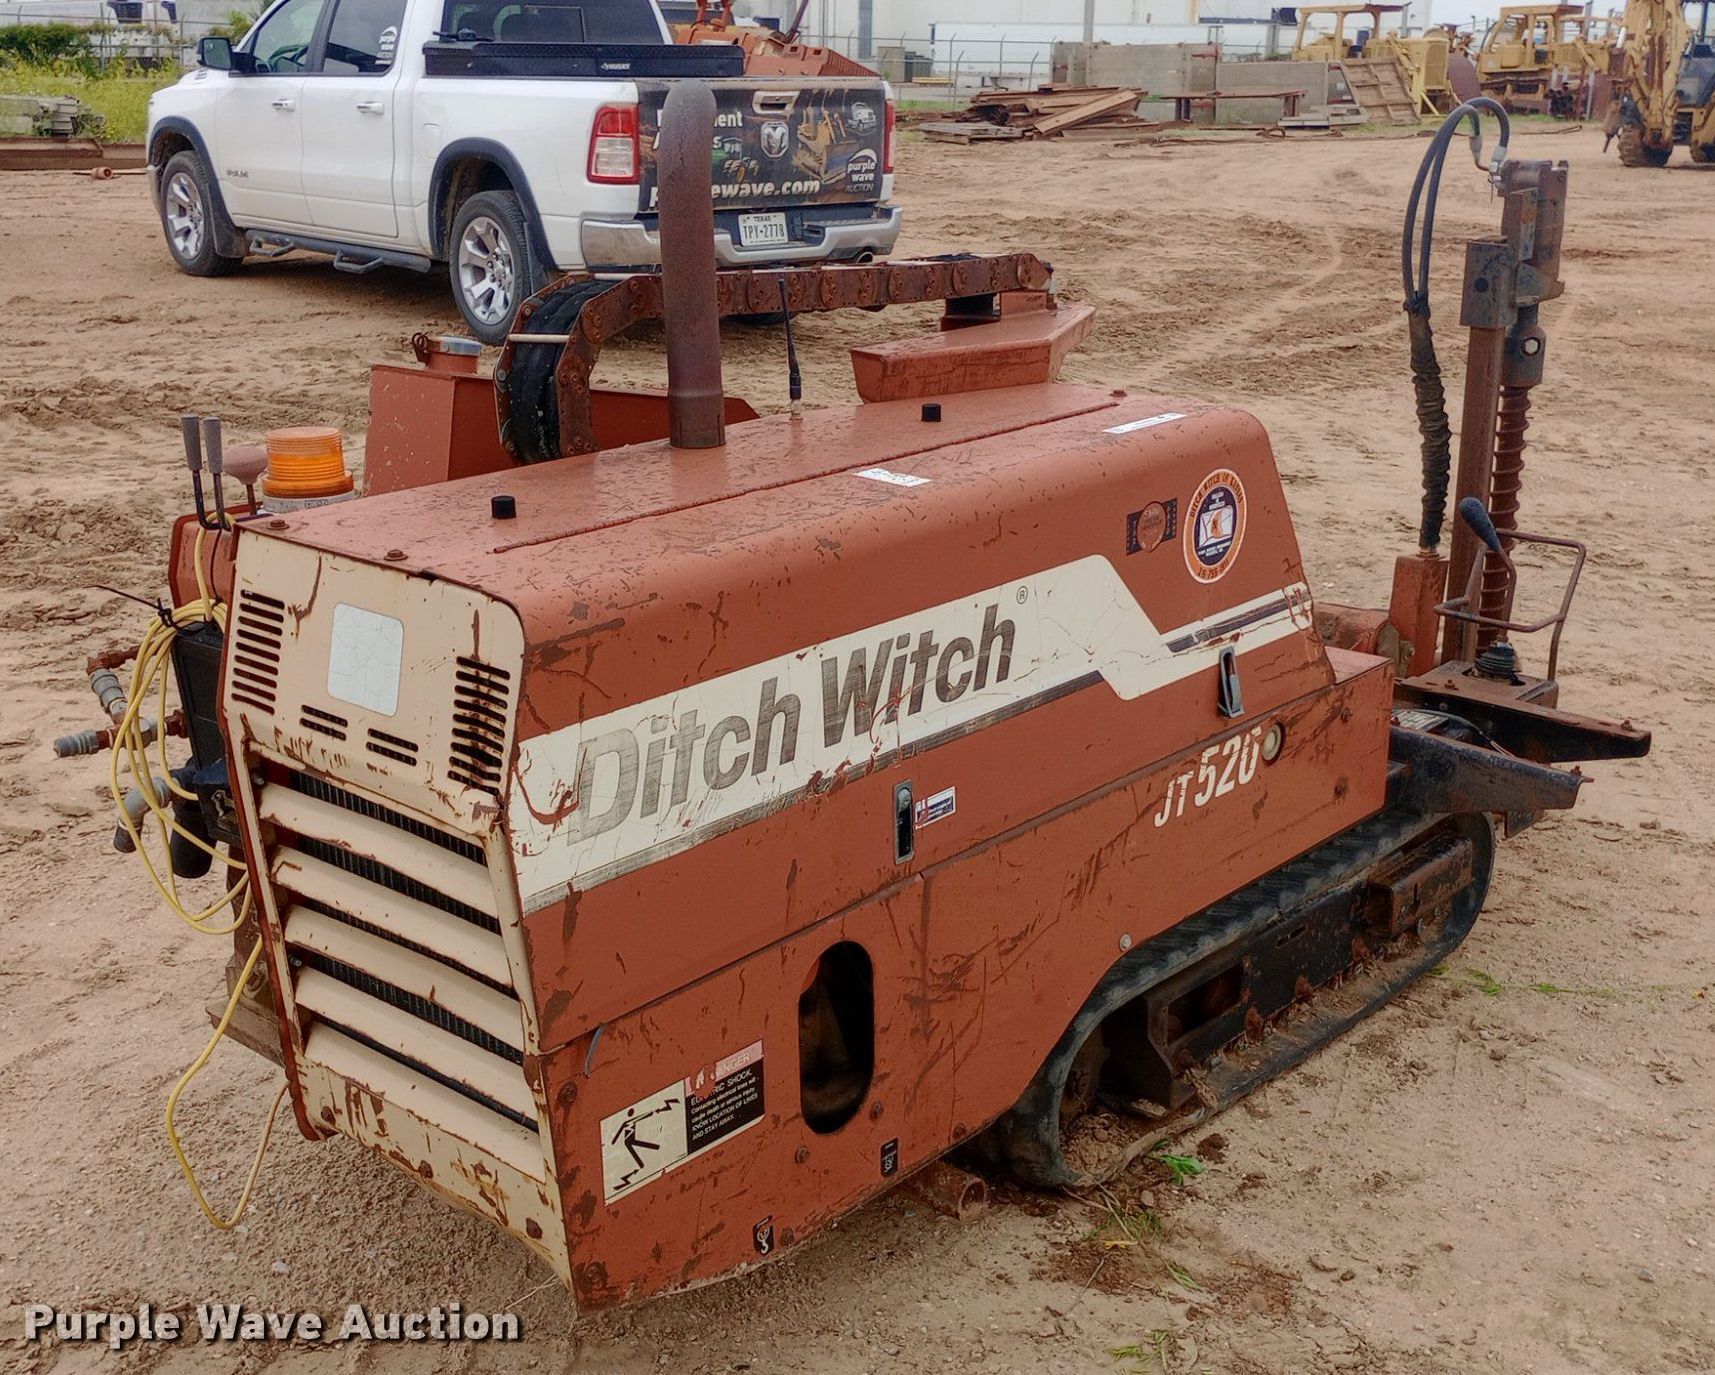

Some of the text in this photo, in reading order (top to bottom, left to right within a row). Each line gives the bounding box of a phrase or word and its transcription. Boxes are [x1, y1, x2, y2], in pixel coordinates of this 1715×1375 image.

[847, 160, 877, 173] purple
[851, 173, 875, 182] wave
[568, 603, 1017, 846] Ditch Witch
[691, 1118, 708, 1131] KNOW
[709, 1104, 734, 1122] LOCATION
[704, 1122, 717, 1133] STAY
